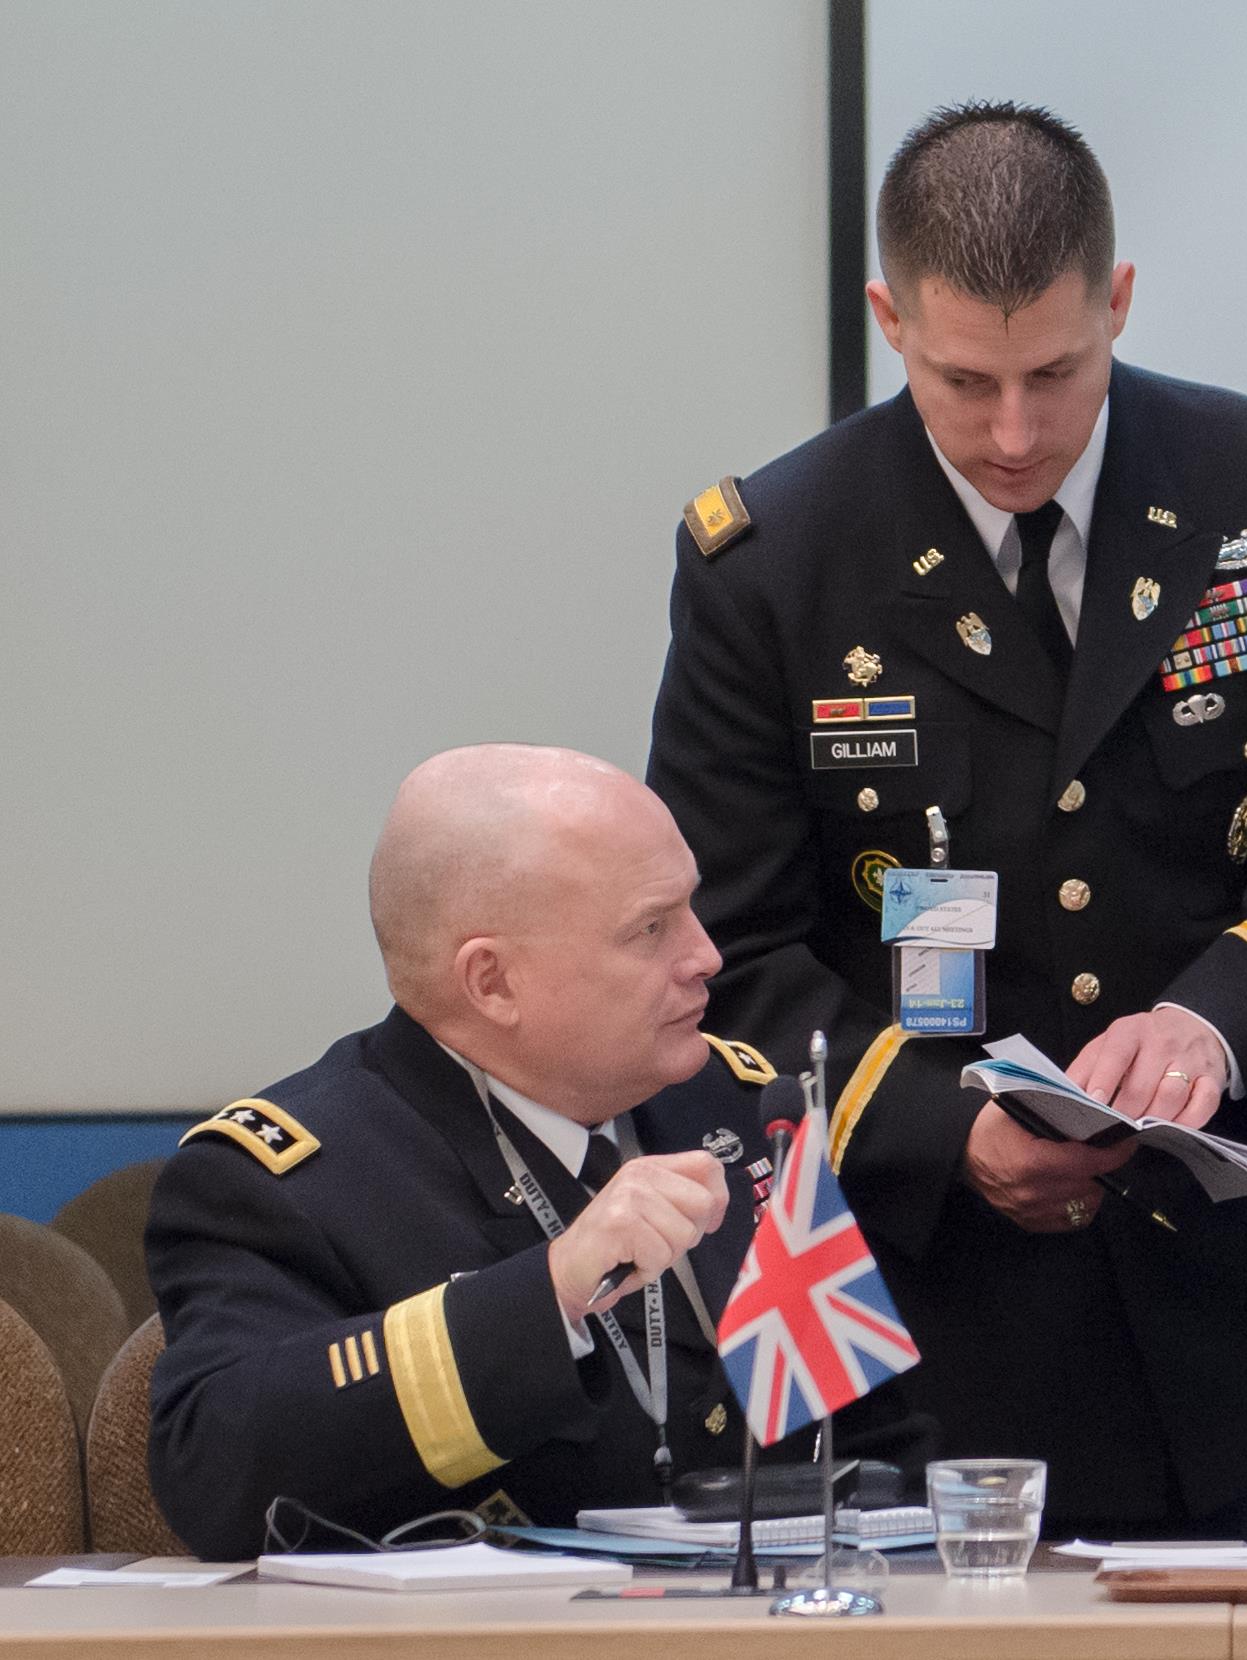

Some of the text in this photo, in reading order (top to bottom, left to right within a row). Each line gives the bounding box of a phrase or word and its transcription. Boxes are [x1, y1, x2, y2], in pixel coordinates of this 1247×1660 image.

[1147, 505, 1178, 529] US
[912, 547, 945, 576] US
[831, 741, 897, 759] GILLIAM
[520, 1172, 550, 1211] DUTY
[602, 1310, 628, 1350] NTRY
[649, 1305, 663, 1348] DUTY
